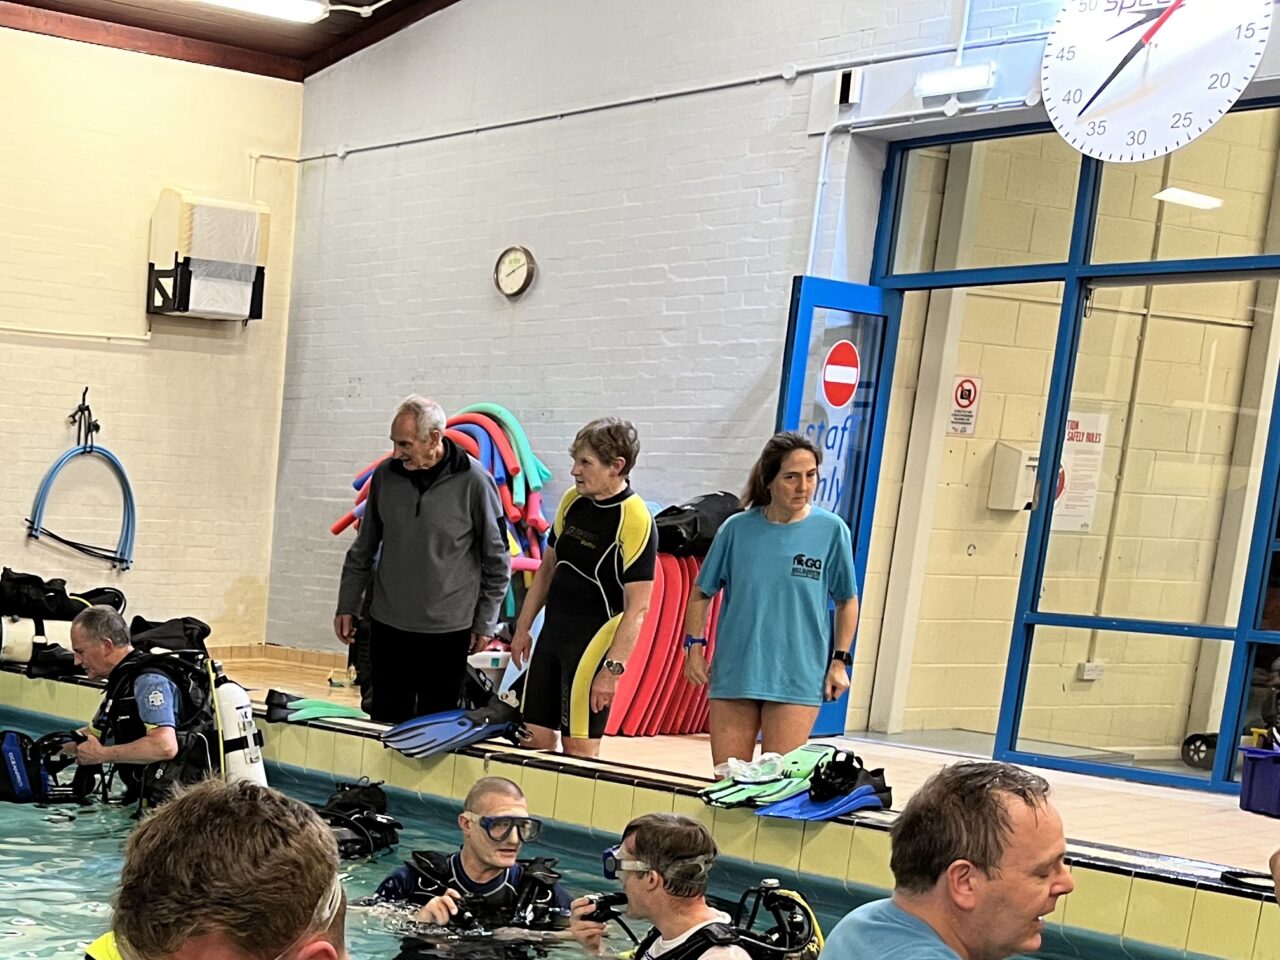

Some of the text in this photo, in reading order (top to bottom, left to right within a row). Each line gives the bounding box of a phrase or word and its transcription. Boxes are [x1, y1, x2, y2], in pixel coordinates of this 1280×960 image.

[1235, 22, 1256, 40] 15
[1055, 45, 1076, 62] 45
[1208, 72, 1231, 90] 20
[1062, 88, 1083, 105] 40
[1086, 120, 1107, 137] 35
[1170, 111, 1193, 129] 25
[1126, 129, 1147, 147] 30
